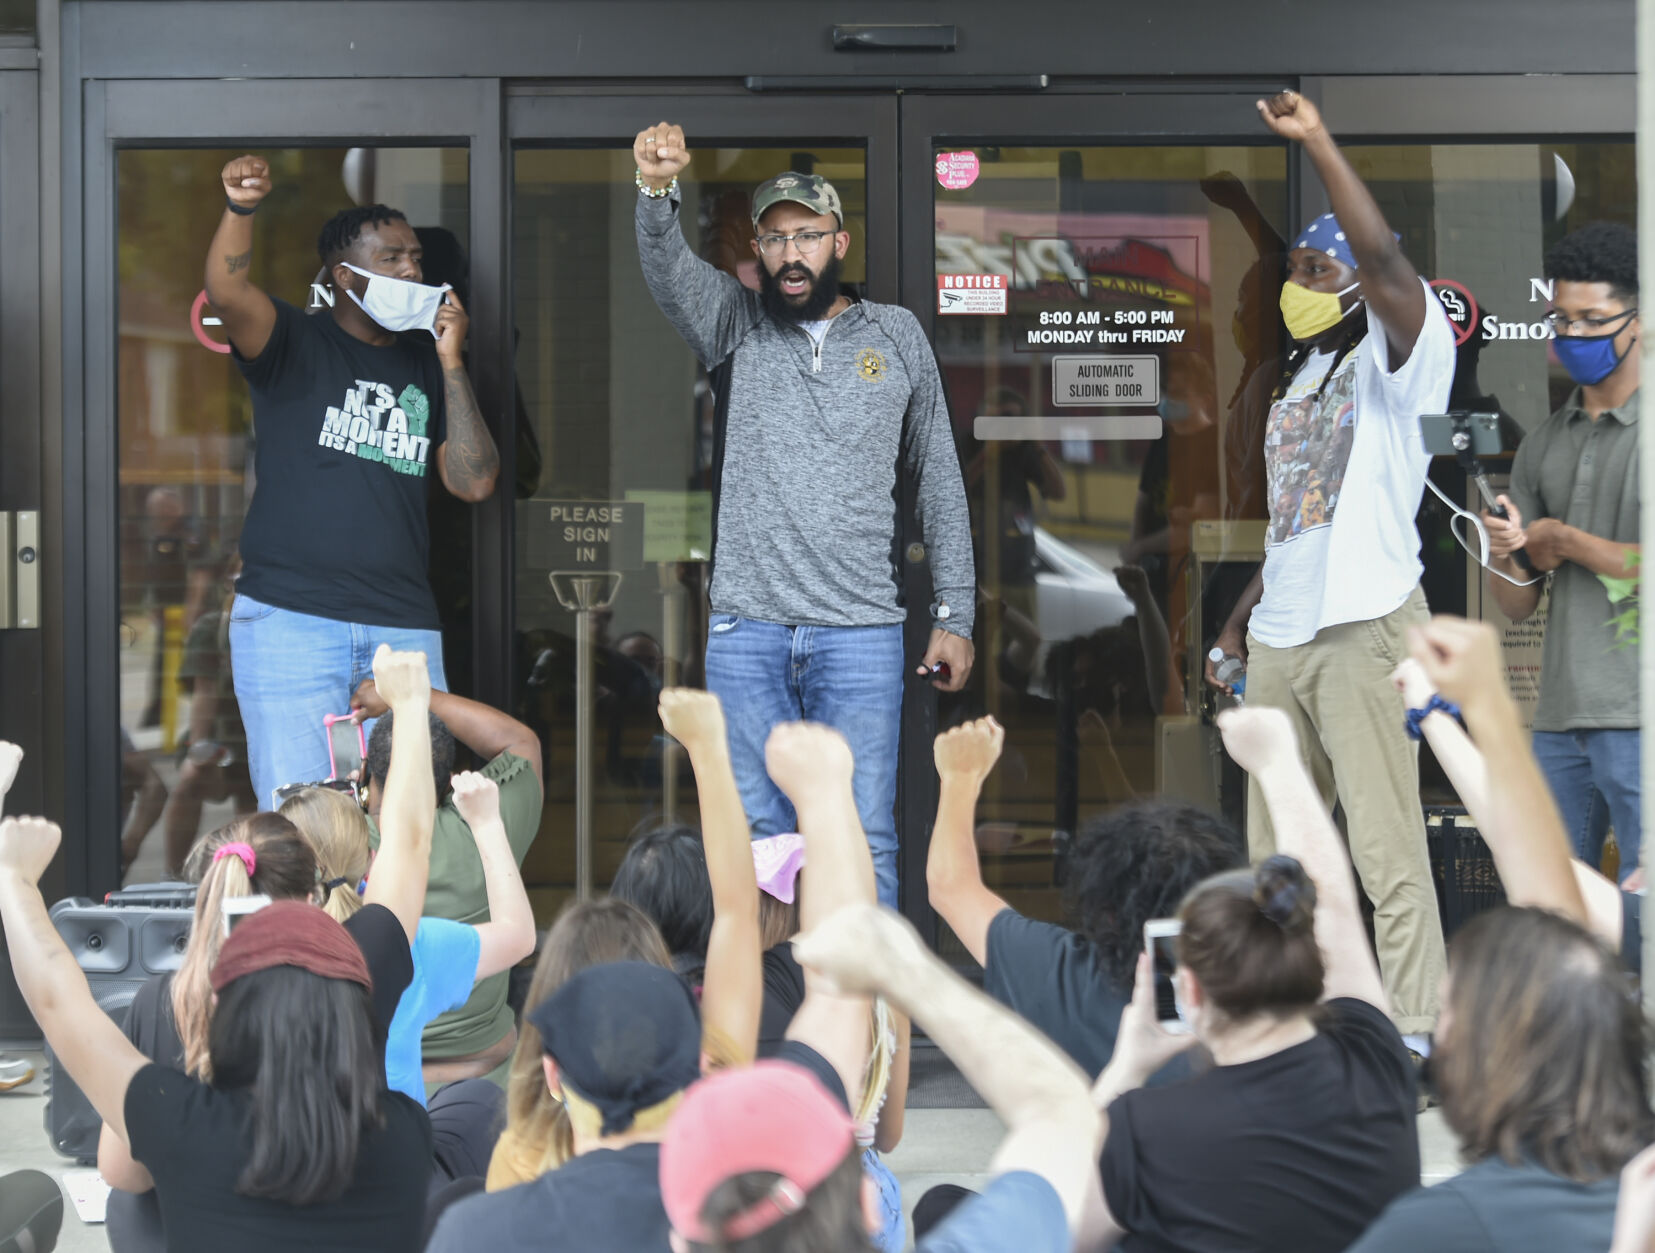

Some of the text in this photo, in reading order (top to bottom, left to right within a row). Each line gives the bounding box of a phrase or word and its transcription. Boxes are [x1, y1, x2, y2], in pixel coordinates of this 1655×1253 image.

[945, 275, 1000, 289] NOTICE
[310, 283, 336, 307] N
[1529, 278, 1555, 302] N
[1039, 311, 1072, 325] 8:00
[1076, 311, 1100, 325] AM
[1114, 310, 1146, 324] 5:00
[1150, 310, 1174, 324] PM
[1027, 329, 1186, 344] MONDAY thru FRIDAY
[1077, 364, 1134, 379] AUTOMATIC
[1069, 383, 1142, 398] SLIDING DOOR
[386, 407, 408, 434] A
[344, 440, 358, 455] A
[551, 507, 623, 523] PLEASE
[563, 527, 610, 543] SIGN
[576, 547, 595, 562] IN
